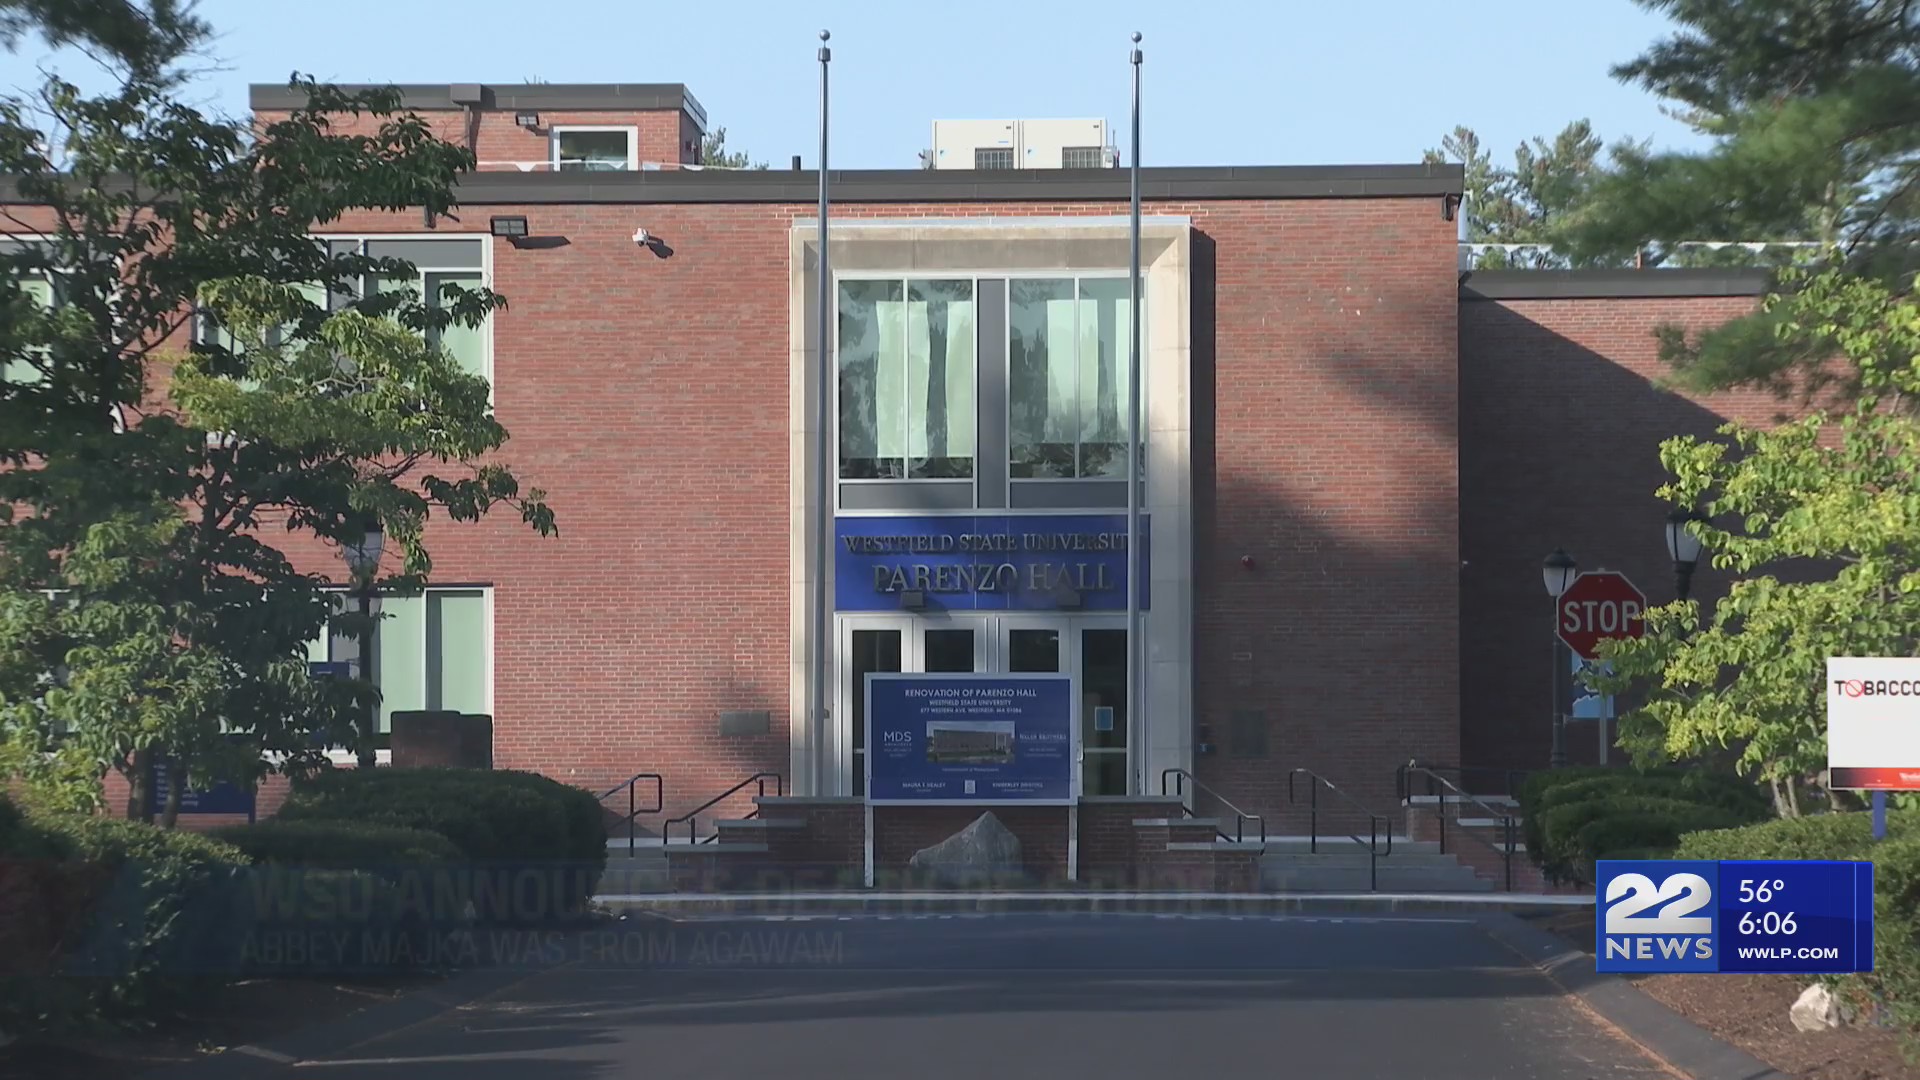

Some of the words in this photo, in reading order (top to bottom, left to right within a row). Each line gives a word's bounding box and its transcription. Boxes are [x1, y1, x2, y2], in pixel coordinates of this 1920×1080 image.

[841, 534, 954, 552] WESTFIELD
[960, 533, 1018, 551] STATE
[1023, 533, 1143, 551] UNIVERSIT
[872, 563, 1018, 592] PARENZO
[1028, 563, 1116, 592] HALL
[1564, 601, 1640, 632] STOP
[905, 689, 960, 698] RENOVATION
[962, 689, 974, 698] OF
[975, 689, 1015, 698] PARENZO
[1016, 689, 1037, 698] HALL
[884, 731, 912, 742] MDS
